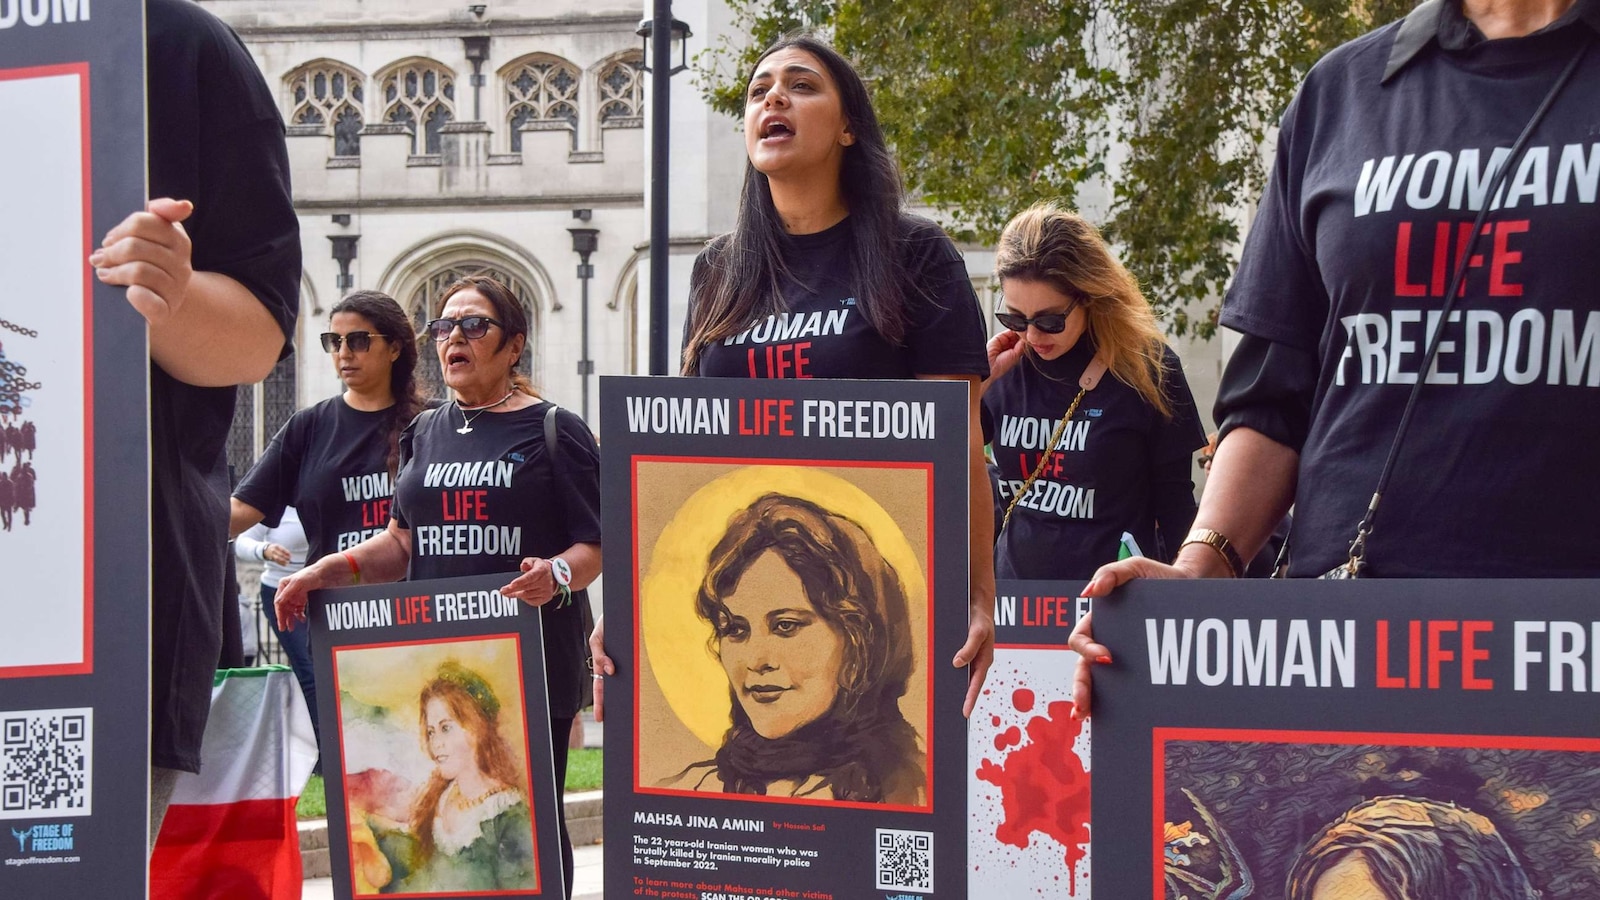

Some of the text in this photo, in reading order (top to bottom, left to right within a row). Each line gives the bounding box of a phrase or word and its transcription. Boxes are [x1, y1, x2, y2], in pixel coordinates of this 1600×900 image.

[1354, 143, 1600, 217] WOMAN
[1394, 220, 1531, 297] LIFE
[747, 342, 813, 379] LIFE
[1335, 308, 1600, 387] FREEDOM
[626, 396, 935, 439] WOMAN LIFE FREEDOM
[1000, 415, 1091, 451] WOMAN
[341, 472, 396, 502] WOMA
[424, 460, 514, 488] WOMAN
[362, 499, 393, 528] LIF
[441, 490, 489, 521] LIFE
[417, 525, 522, 556] FREEDOM
[325, 589, 519, 631] WOMAN LIFE FREEDOM
[1023, 596, 1069, 626] LIFE
[1145, 618, 1600, 693] WOMAN LIFE FR
[32, 823, 74, 838] STAGE OF
[633, 811, 683, 827] MAHSA
[686, 815, 718, 829] JINA
[722, 818, 764, 832] AMINI
[772, 820, 782, 830] by
[32, 837, 74, 852] FREEDOM
[633, 835, 818, 857] The 22 years-old Iranian woman who was
[633, 845, 811, 868] brutally killed by Iranian morality police
[4, 856, 81, 866] stageoffreedom.com
[633, 855, 718, 870] in September 2022.
[633, 876, 833, 900] To learn more about Mahsa and other victims
[633, 886, 643, 895] of
[645, 887, 659, 897] the
[661, 891, 699, 900] protests,
